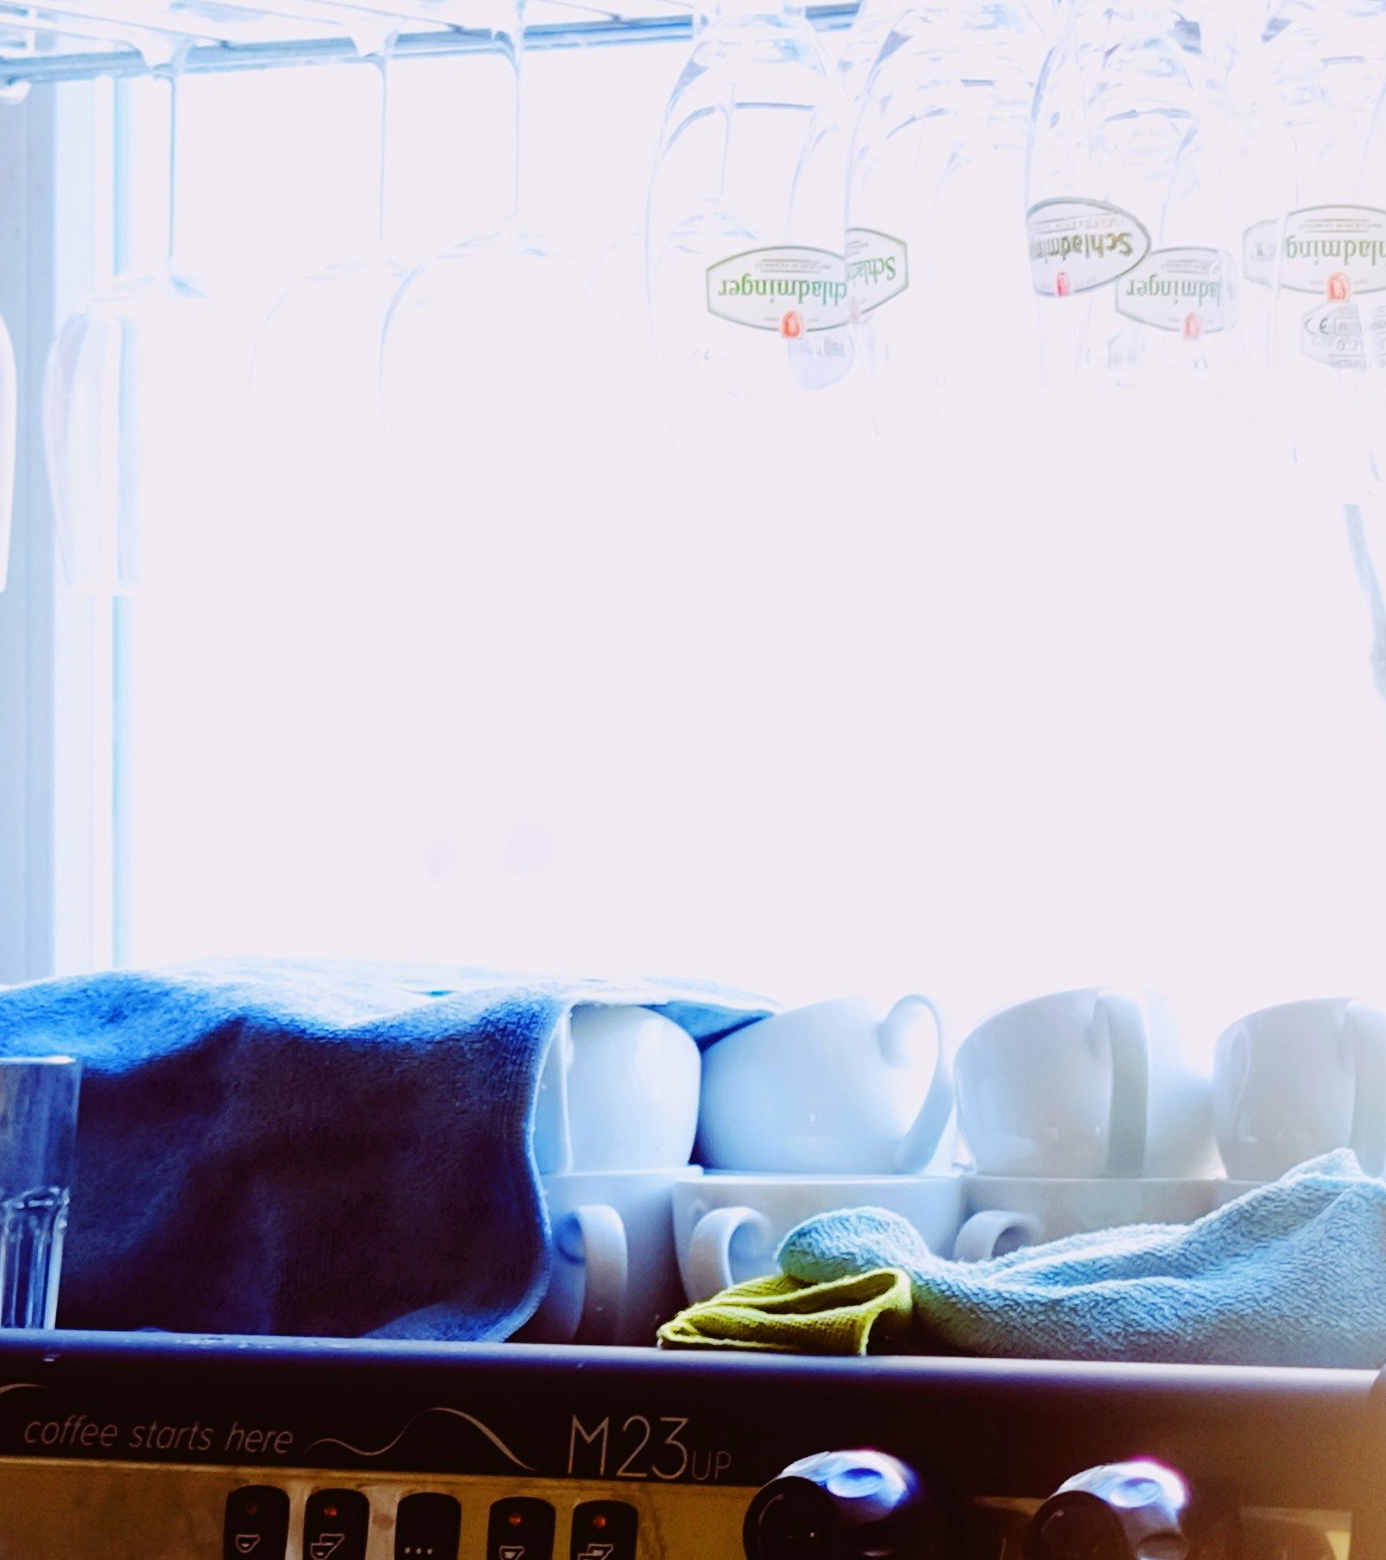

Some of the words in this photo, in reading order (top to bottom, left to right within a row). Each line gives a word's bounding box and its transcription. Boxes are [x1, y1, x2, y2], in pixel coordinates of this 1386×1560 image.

[718, 271, 848, 306] chladminger
[23, 1414, 118, 1447] coffee
[128, 1420, 215, 1452] starts
[224, 1421, 294, 1455] here
